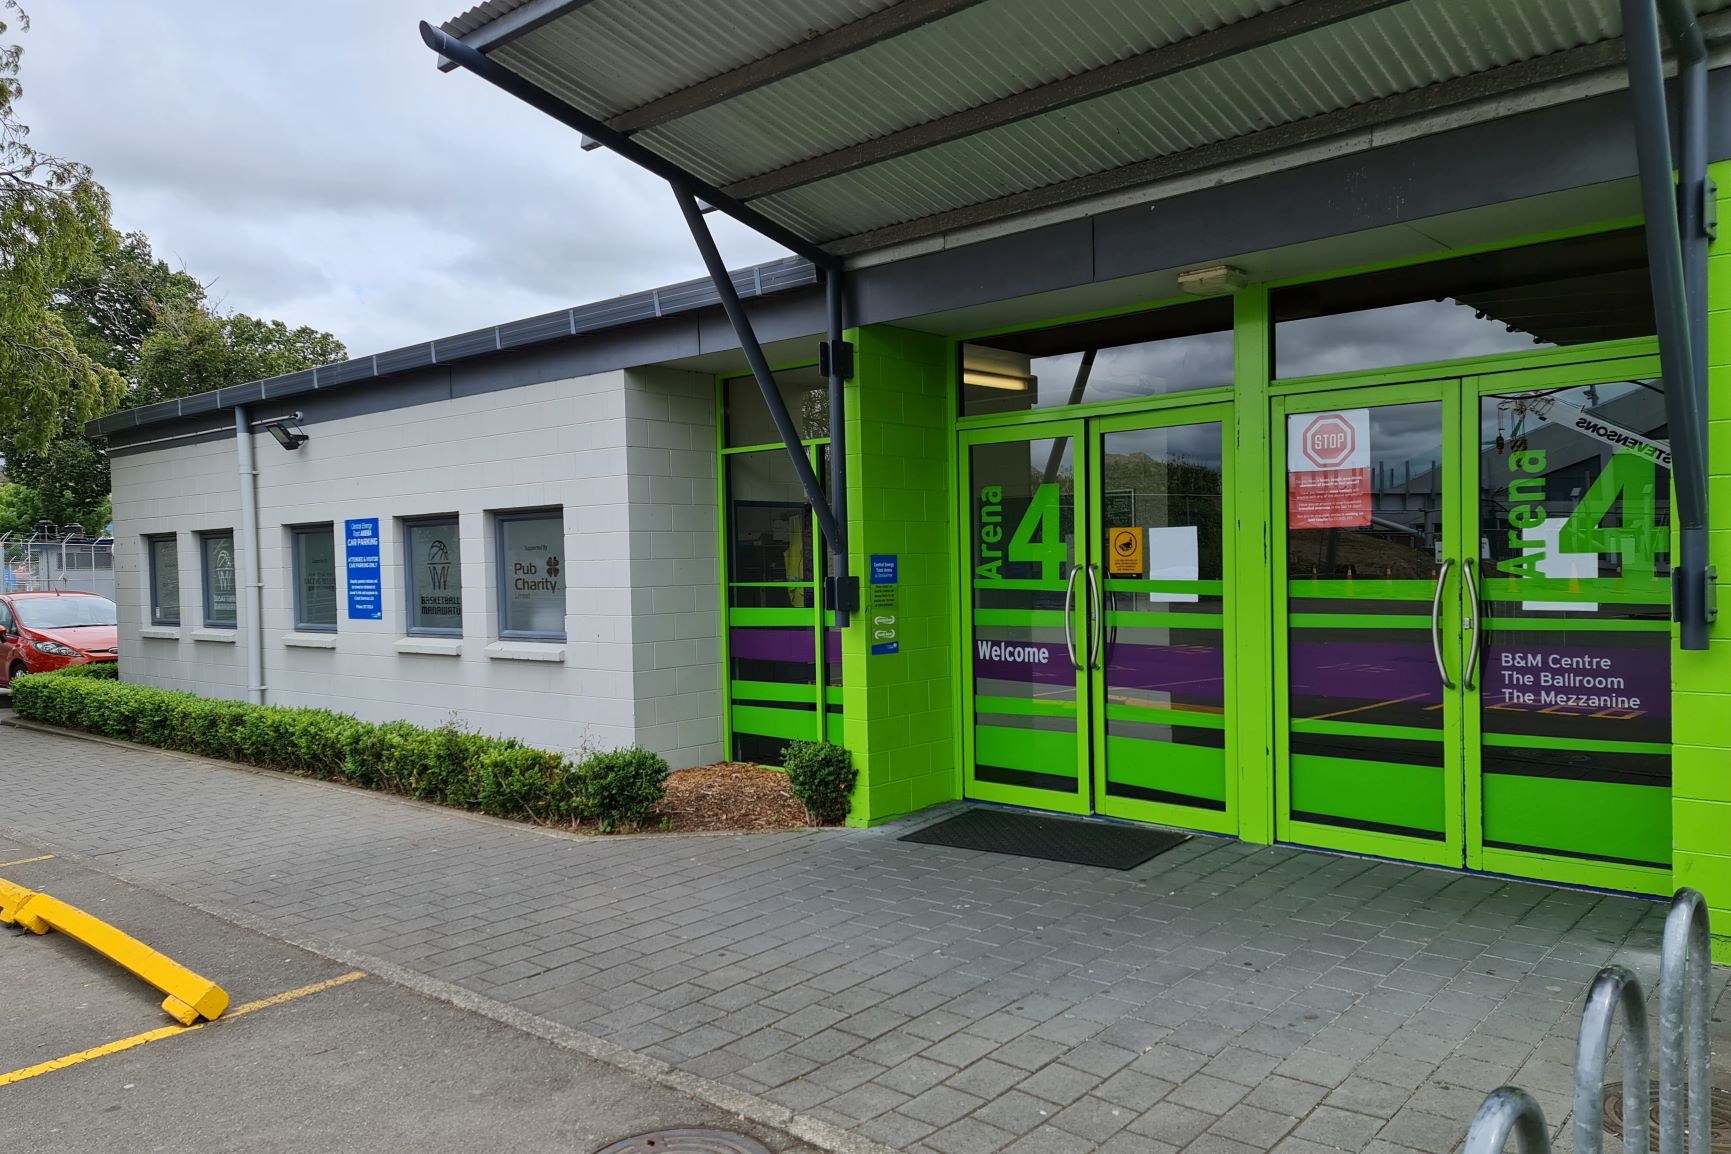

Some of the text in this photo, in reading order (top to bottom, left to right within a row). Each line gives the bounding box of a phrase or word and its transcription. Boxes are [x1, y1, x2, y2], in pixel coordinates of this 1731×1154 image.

[1314, 434, 1345, 450] STOP
[1496, 449, 1547, 579] Arena
[1558, 453, 1669, 579] 4
[975, 485, 1002, 580] Arena
[1008, 483, 1068, 581] 4
[514, 562, 537, 575] Pub
[514, 578, 557, 594] Charity
[420, 596, 461, 605] BASKETBALL
[977, 640, 1049, 664] Welcome
[1501, 653, 1611, 670] B&M Centre
[1501, 671, 1624, 689] The Ballroom
[1501, 689, 1641, 709] The Mezzanine
